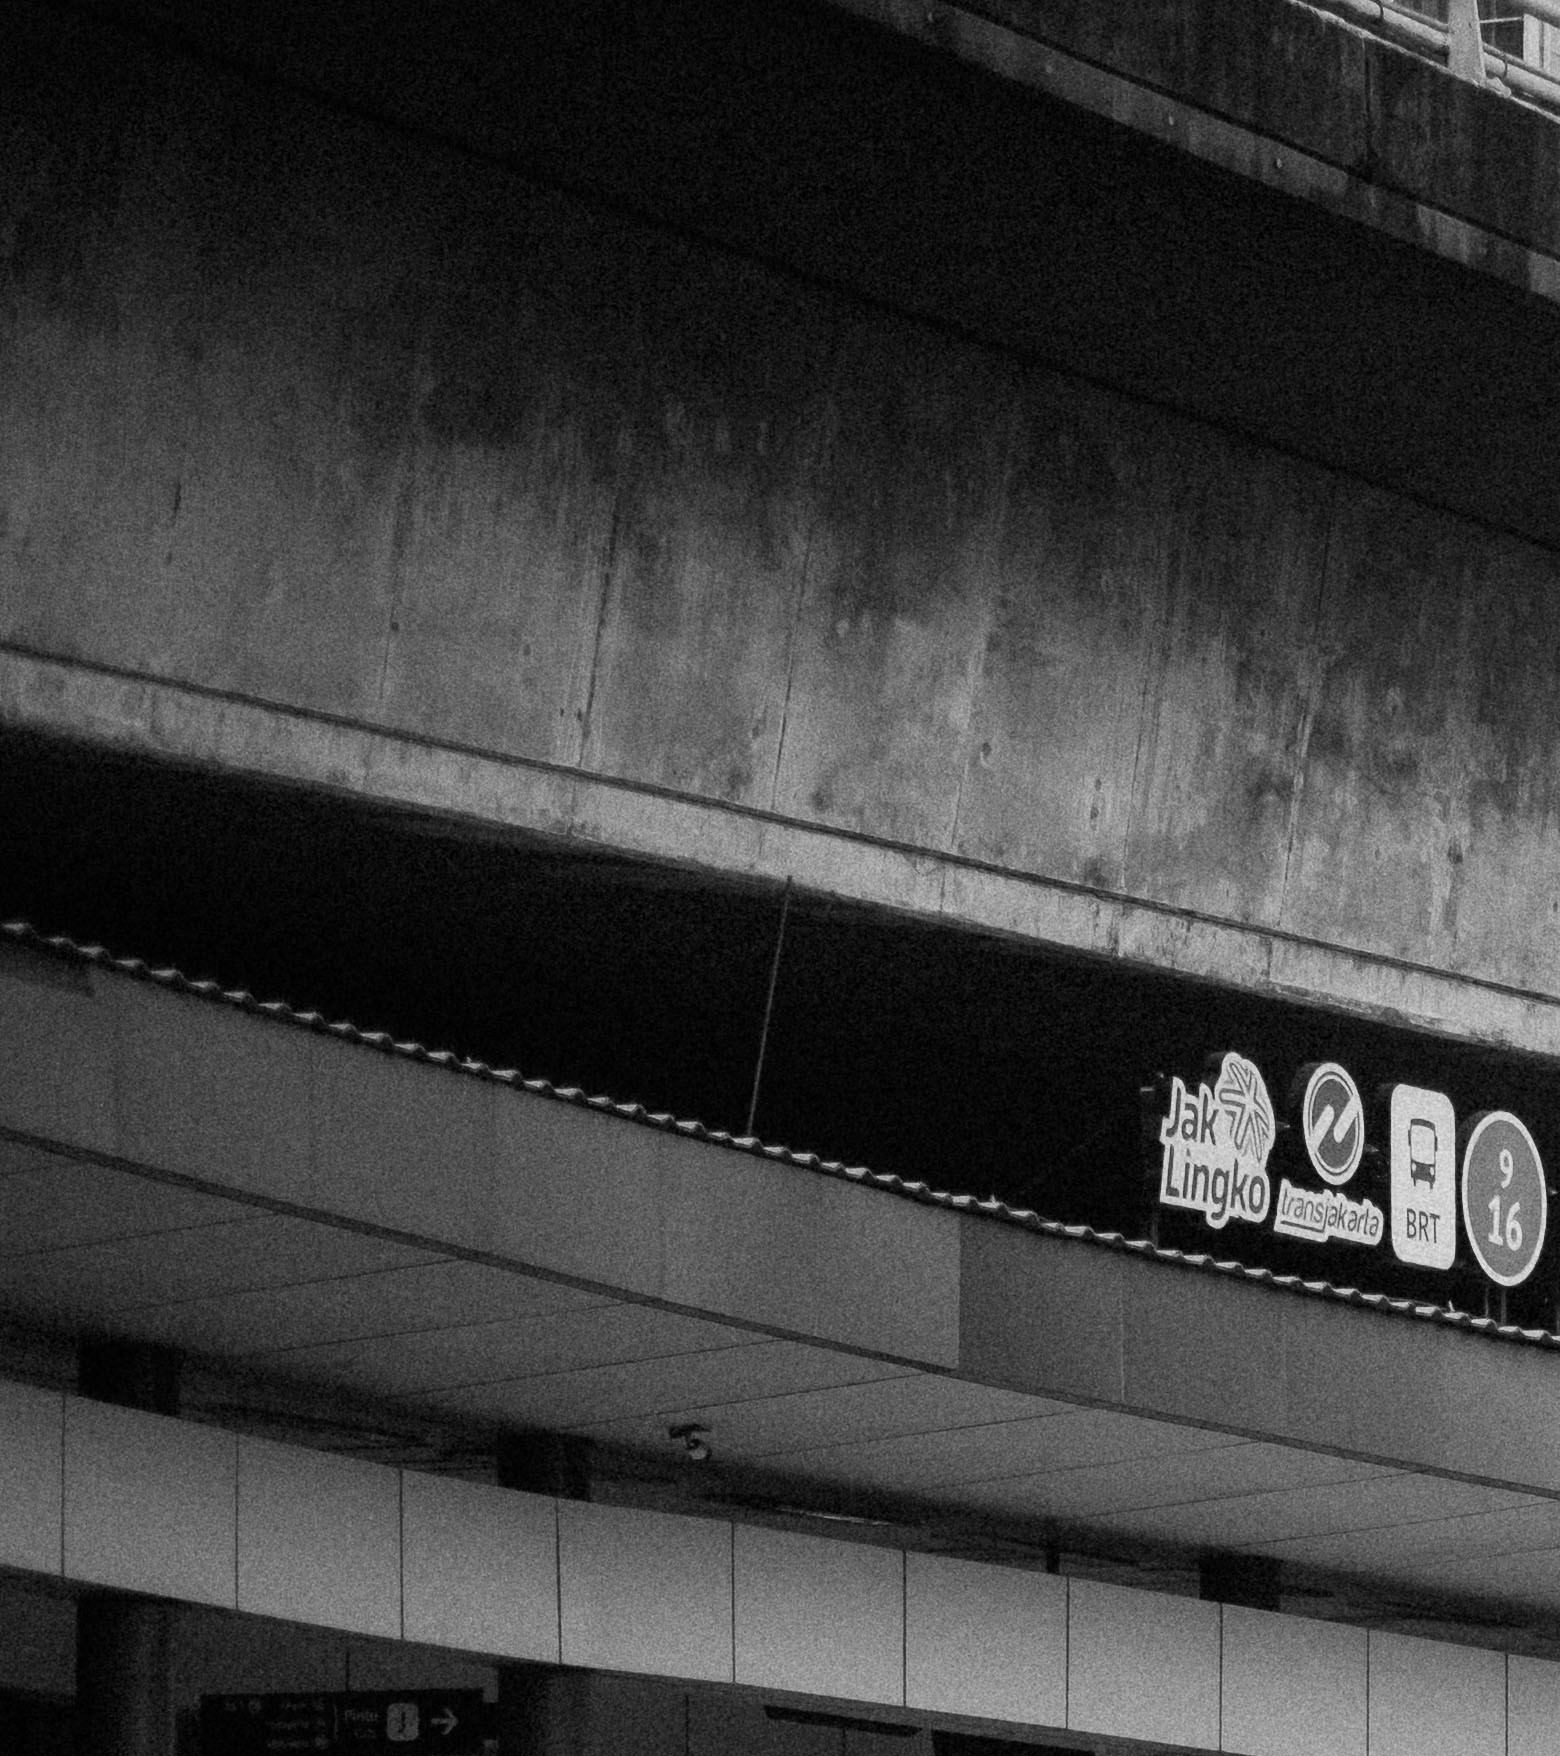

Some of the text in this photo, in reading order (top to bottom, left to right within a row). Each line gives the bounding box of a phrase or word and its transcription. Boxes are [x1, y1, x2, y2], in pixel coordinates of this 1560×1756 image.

[1165, 1086, 1219, 1145] Jak
[1165, 1143, 1265, 1221] Lingko
[1498, 1148, 1514, 1189] 9
[1280, 1188, 1381, 1238] transjakarta
[1405, 1208, 1441, 1244] BRT
[1487, 1194, 1524, 1252] 16
